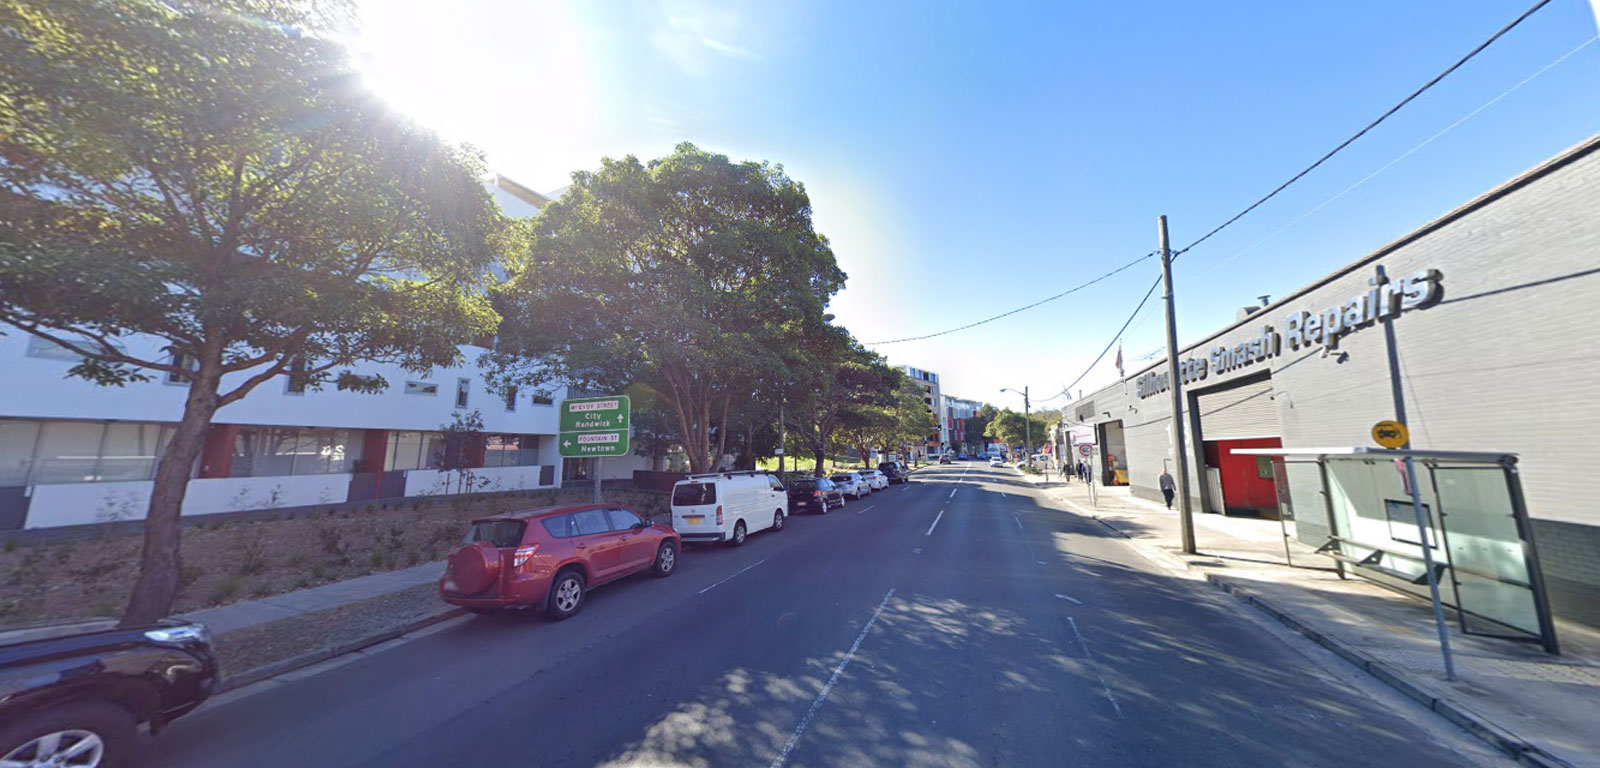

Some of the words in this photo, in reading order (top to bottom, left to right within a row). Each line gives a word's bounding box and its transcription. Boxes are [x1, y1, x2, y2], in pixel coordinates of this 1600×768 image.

[1136, 358, 1208, 399] Silhoutte
[1209, 325, 1281, 374] Smash
[1283, 268, 1442, 350] Repairs
[596, 401, 618, 410] STREET
[585, 412, 602, 420] City
[575, 420, 611, 428] Randwick
[578, 435, 608, 443] FOUNTAIN
[580, 445, 616, 453] Newtown
